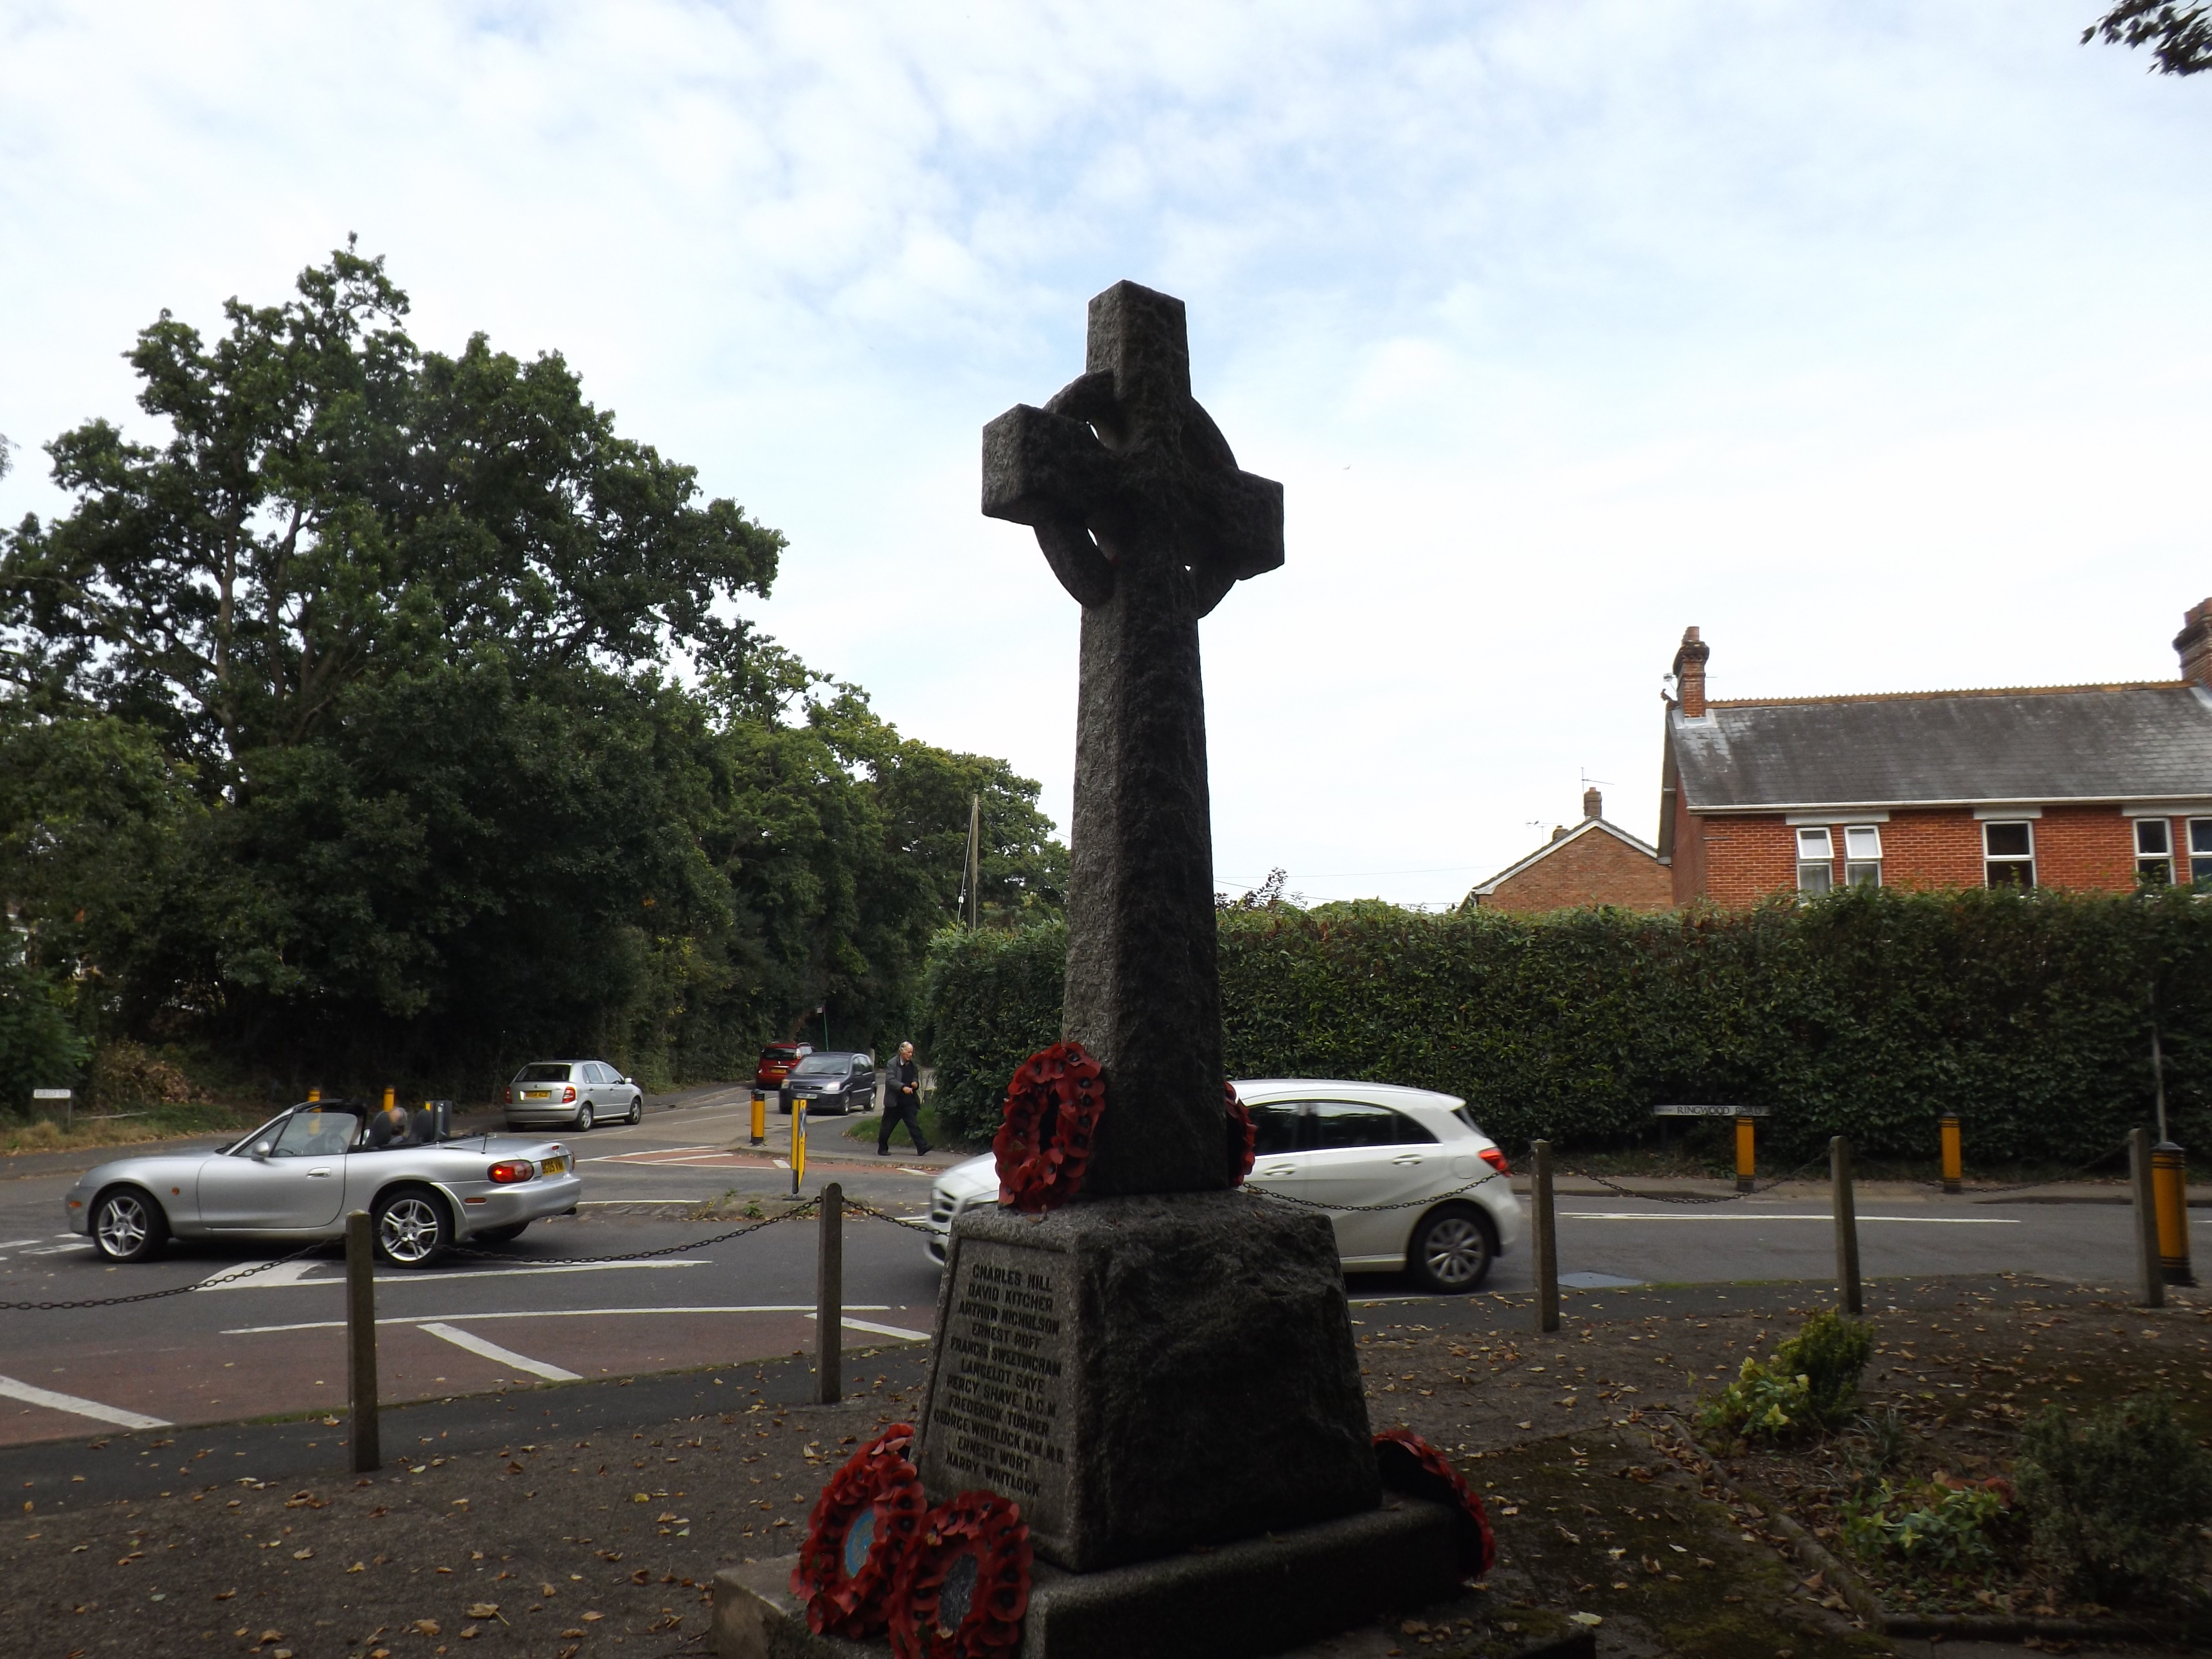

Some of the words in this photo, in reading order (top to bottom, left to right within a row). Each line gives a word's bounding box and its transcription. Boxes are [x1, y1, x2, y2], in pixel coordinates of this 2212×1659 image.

[1678, 1106, 1730, 1114] RINGWOOD
[972, 1264, 1022, 1286] CHARLES
[1028, 1274, 1052, 1292] HILL
[969, 1282, 1000, 1301] DAVID
[1005, 1289, 1053, 1312] KITCHER
[958, 1300, 998, 1321] ARTHUR
[1002, 1309, 1060, 1335] NICHOLSON
[951, 1336, 988, 1358] FRANCIS
[972, 1322, 1012, 1343] ERNEST
[1015, 1333, 1044, 1349] ROFF
[961, 1357, 1012, 1384] LANCELOT
[947, 1375, 980, 1395] PERCY
[984, 1384, 1019, 1408] SHAVE
[934, 1410, 968, 1432] GEORGE
[972, 1420, 1020, 1449] WHITLOCK
[949, 1395, 1003, 1421] FREDERICK
[1007, 1410, 1049, 1436] TURNER
[958, 1436, 996, 1460] ERNEST
[1000, 1450, 1030, 1473] WORT
[947, 1451, 979, 1474] HARRY
[985, 1466, 1040, 1497] WHITLOCK
